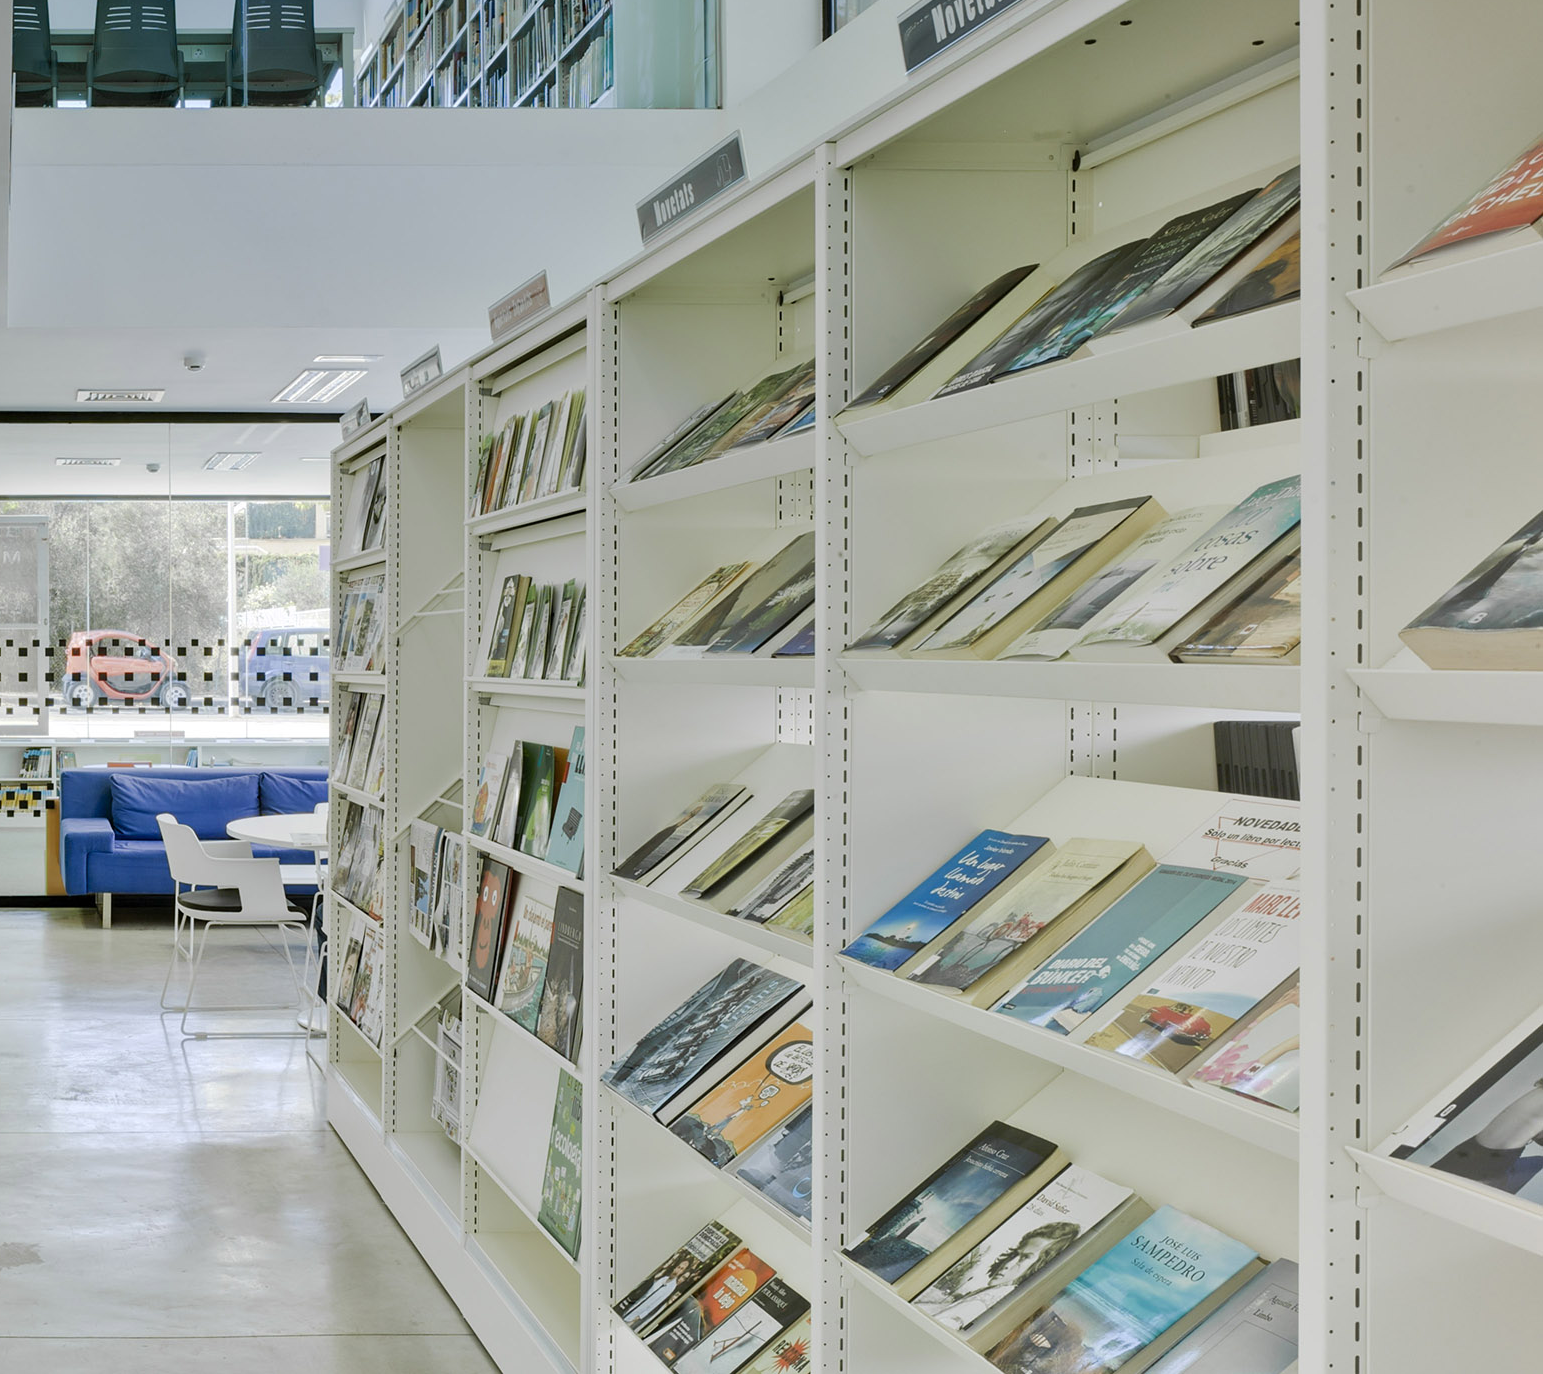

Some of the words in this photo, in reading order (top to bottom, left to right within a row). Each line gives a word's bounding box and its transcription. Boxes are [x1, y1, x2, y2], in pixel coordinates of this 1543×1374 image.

[653, 183, 695, 226] Novetats
[1194, 530, 1259, 553] cosas
[1205, 828, 1227, 838] Solo
[1227, 832, 1239, 840] un
[1241, 833, 1262, 842] libro
[1211, 856, 1248, 869] Gracias
[1242, 893, 1292, 915] MARC
[1048, 958, 1089, 969] DIARIO
[1083, 958, 1108, 968] DEL
[996, 1149, 1009, 1160] Cruz
[1037, 1193, 1056, 1207] David
[1159, 1236, 1183, 1250] JOSÉ
[1182, 1249, 1202, 1262] LUIS
[1130, 1235, 1206, 1283] SAMPEDRO
[1131, 1258, 1145, 1270] Sala
[1145, 1267, 1153, 1275] de
[1153, 1272, 1173, 1287] espera
[1253, 1308, 1273, 1322] Limbo
